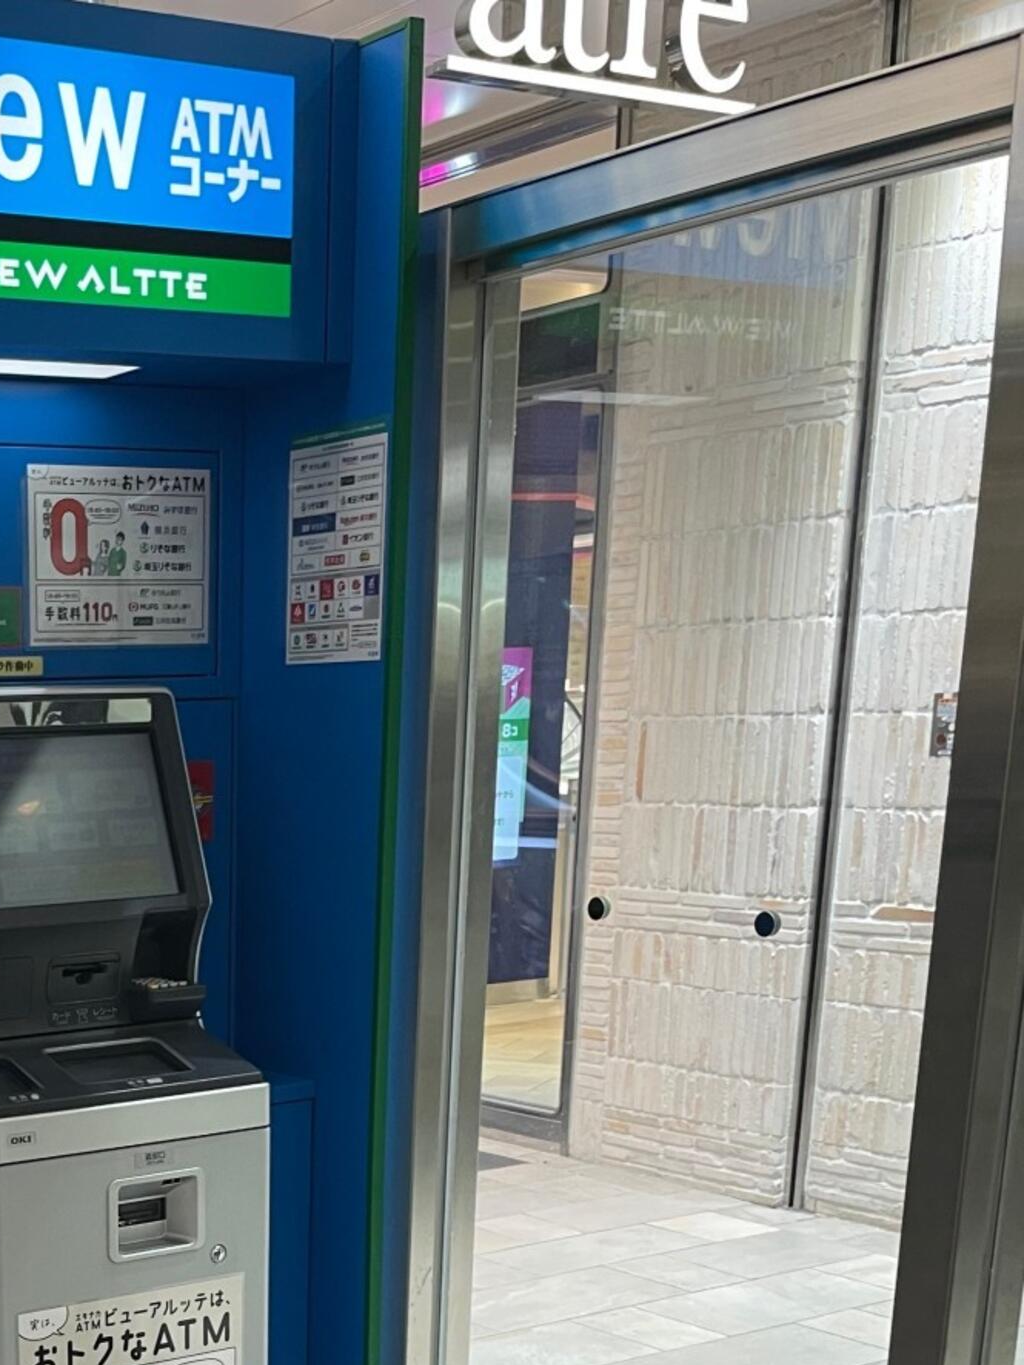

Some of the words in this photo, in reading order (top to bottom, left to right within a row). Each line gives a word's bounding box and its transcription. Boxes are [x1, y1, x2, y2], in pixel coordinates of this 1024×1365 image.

[170, 97, 273, 160] ATM
[169, 156, 282, 203] コーナー
[77, 264, 208, 300] ALTTE
[122, 474, 206, 492] おトクなATM
[10, 1134, 32, 1145] OKI
[75, 1321, 102, 1333] ATM
